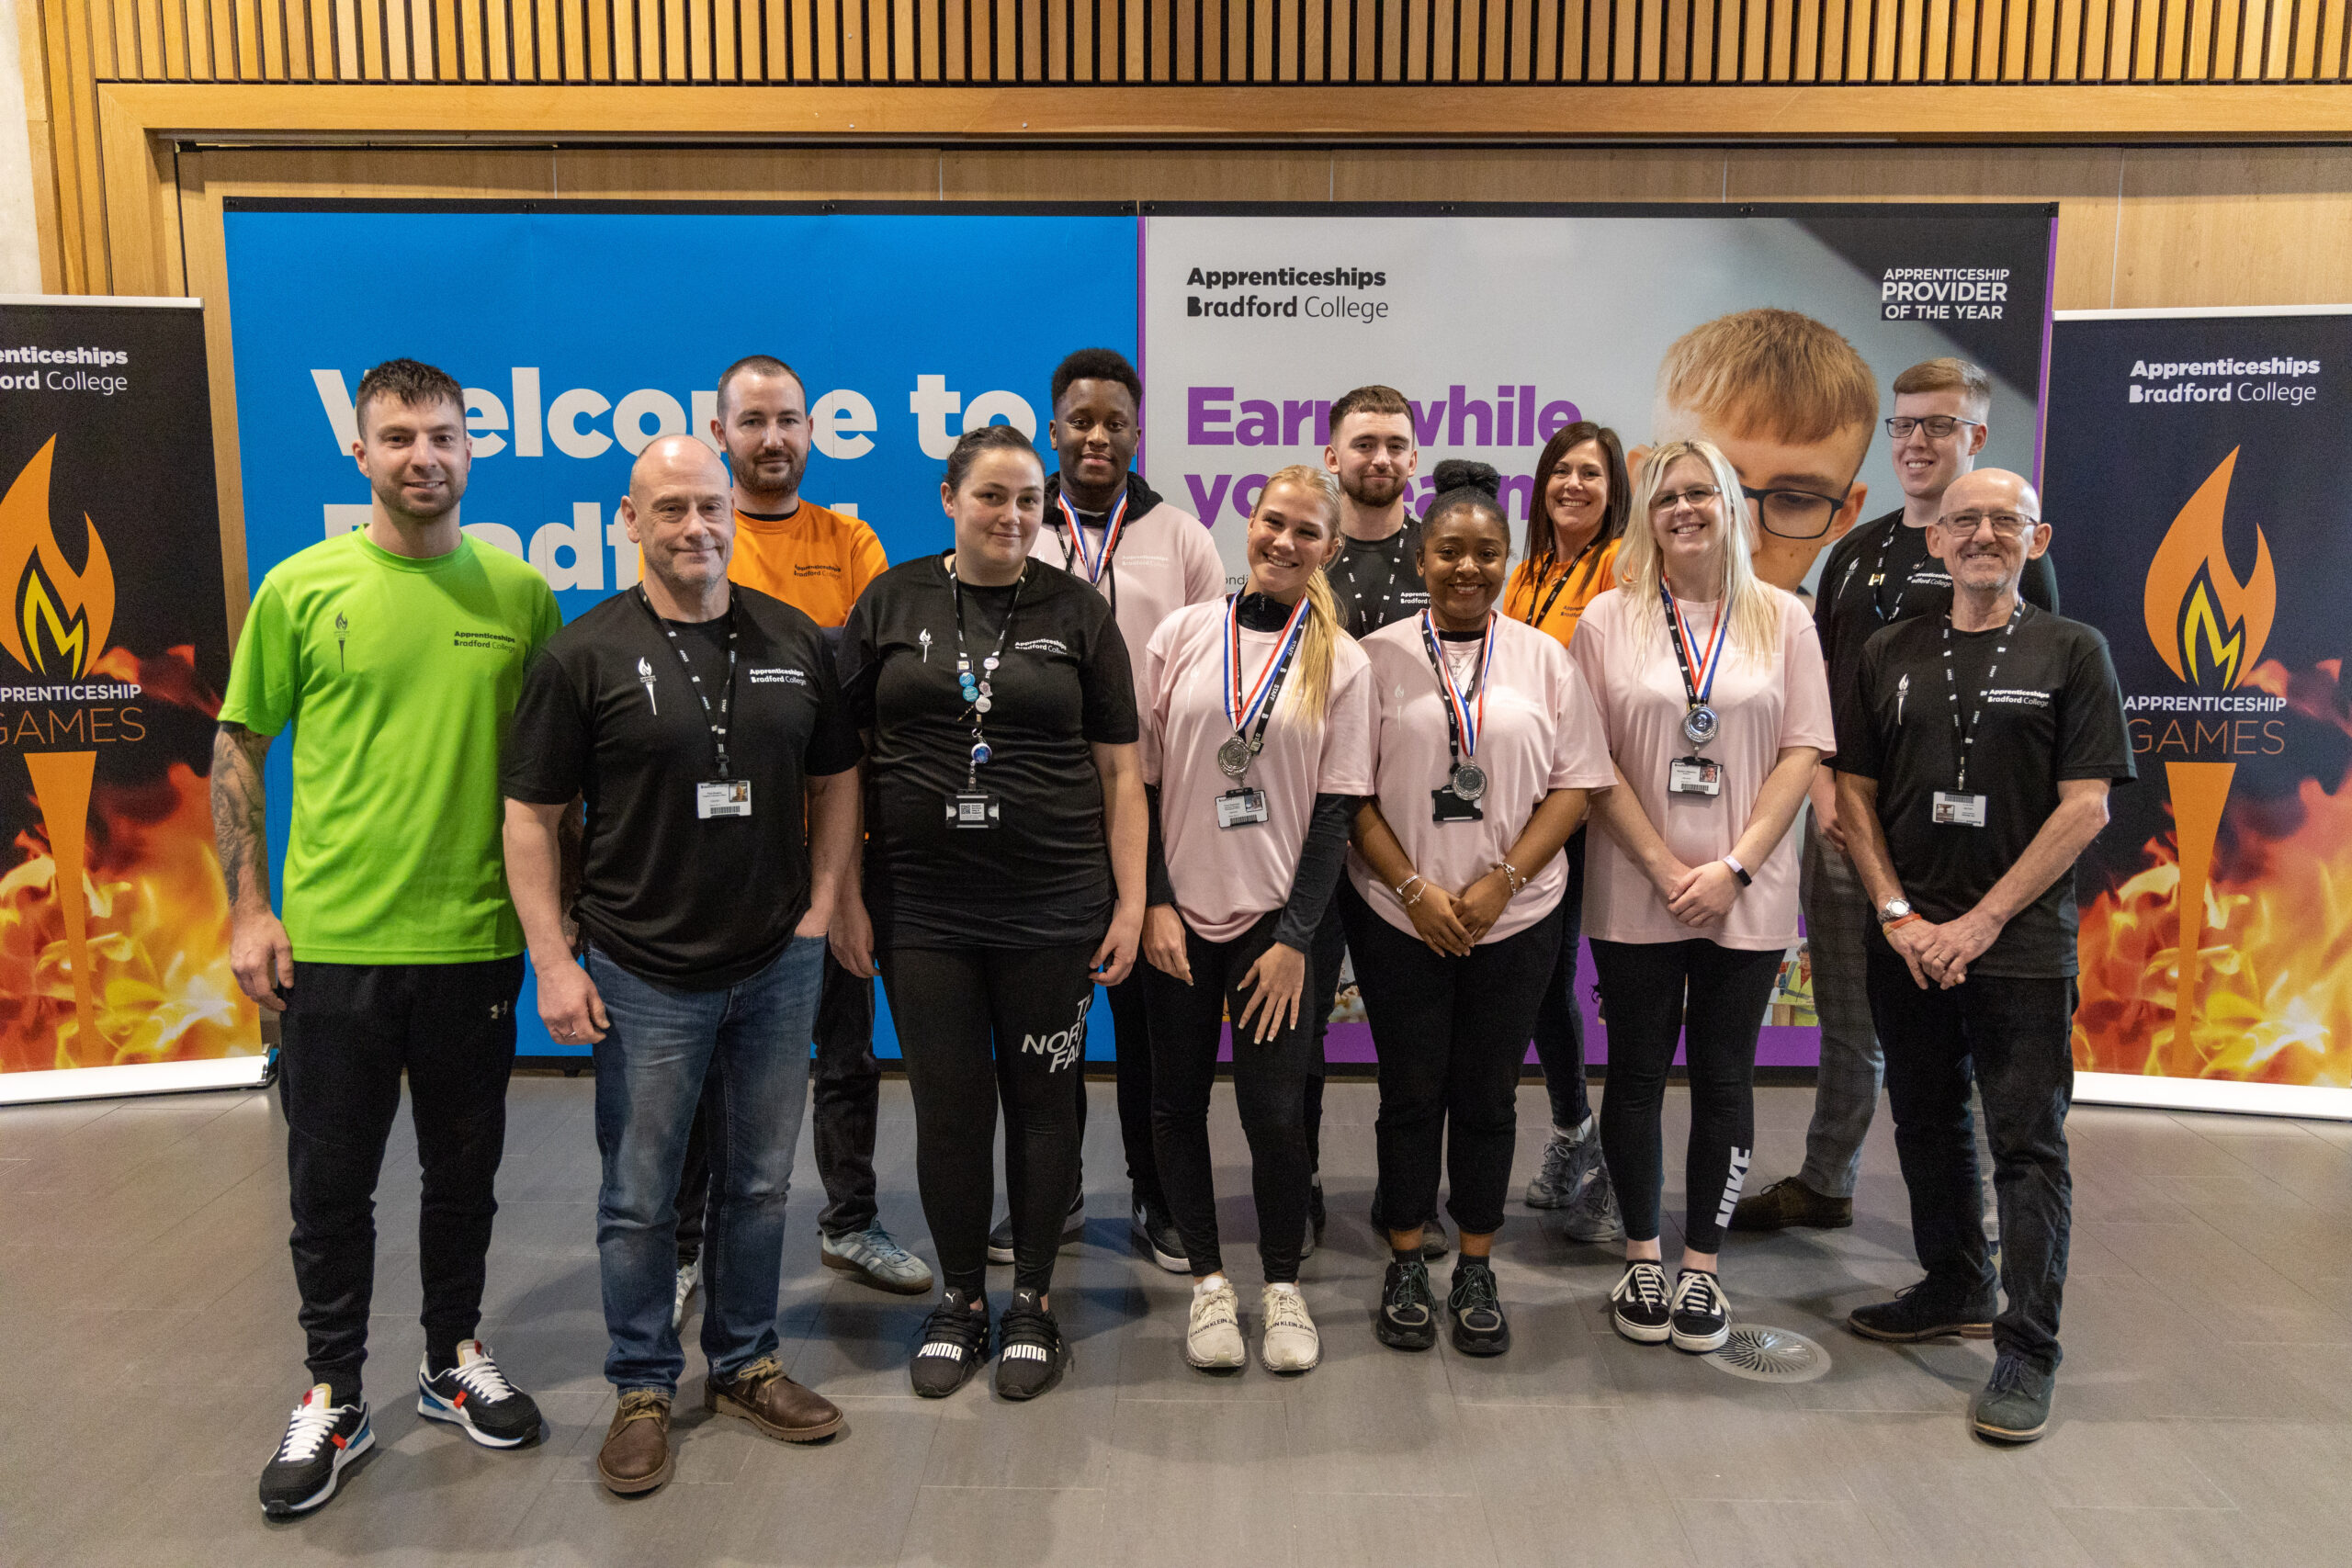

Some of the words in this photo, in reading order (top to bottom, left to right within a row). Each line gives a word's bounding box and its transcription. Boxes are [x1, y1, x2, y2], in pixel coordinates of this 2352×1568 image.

[1187, 267, 1386, 289] Apprenticeships
[1883, 268, 2010, 280] APPRENTICESHIP
[1882, 282, 2008, 302] PROVIDER
[1187, 295, 1297, 317] Bradford
[1305, 296, 1389, 323] College
[1885, 305, 1911, 319] OF
[1916, 306, 1951, 319] THE
[1955, 306, 2003, 320] YEAR
[2130, 356, 2321, 380] Apprenticeships
[46, 371, 128, 396] College
[2129, 382, 2232, 403] Bradford
[2237, 382, 2317, 406] College
[311, 367, 877, 459] elcoe
[910, 374, 1036, 459] to
[454, 639, 491, 648] Bradford
[455, 631, 515, 643] Apprenticeships
[1287, 640, 1298, 658] STAFF
[750, 669, 805, 677] Apprenticeships
[785, 676, 808, 686] College
[1269, 683, 1281, 702] STAFF
[1987, 695, 2023, 704] Bradford
[1989, 689, 2051, 699] Apprenticeships
[2123, 695, 2287, 712] APPRENTICESHIP
[2127, 718, 2285, 755] GAMES
[1022, 1015, 1087, 1055] NORT
[1049, 1032, 1083, 1073] FAC
[1715, 1146, 1750, 1228] NIKE
[1210, 1318, 1227, 1327] KLEIN
[918, 1343, 963, 1361] PUMA
[1003, 1344, 1046, 1362] PUMA
